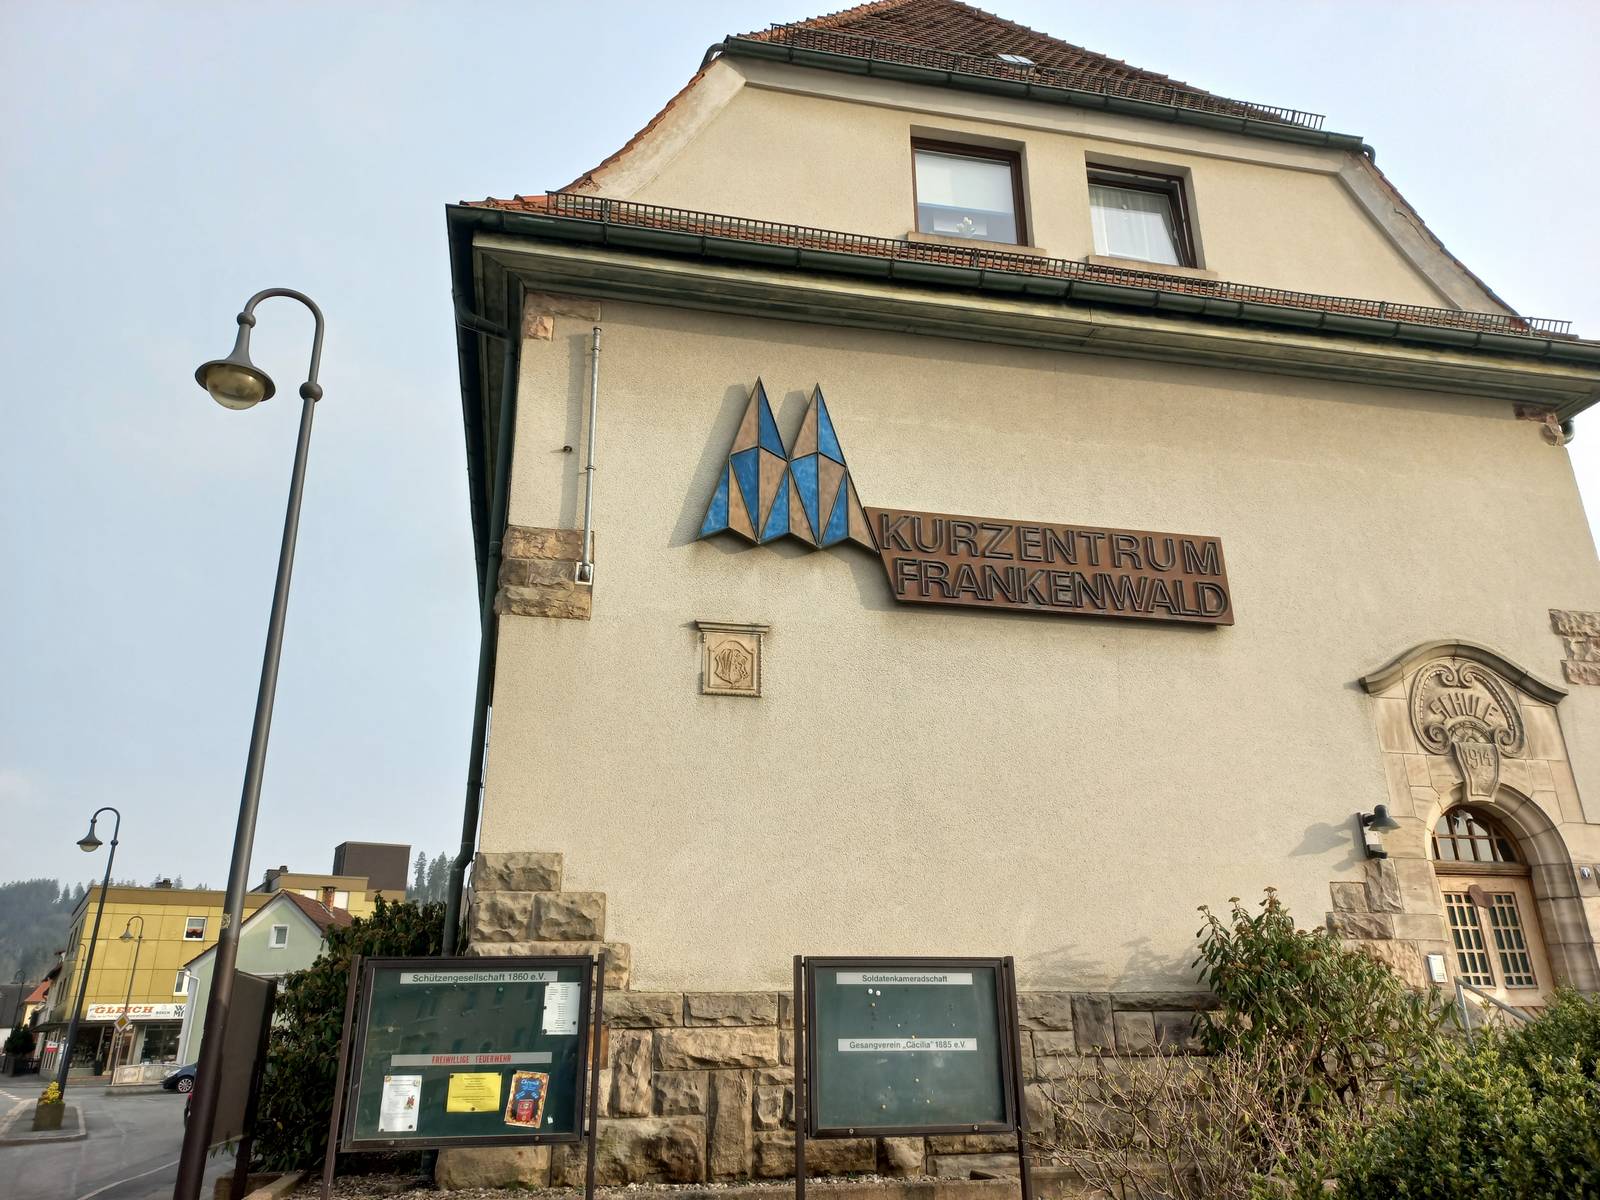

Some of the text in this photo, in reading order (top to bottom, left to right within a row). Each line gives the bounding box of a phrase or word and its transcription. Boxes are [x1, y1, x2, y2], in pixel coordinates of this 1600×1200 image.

[879, 512, 1222, 576] KURZENTRUM
[895, 557, 1228, 618] FRANKENWALD
[1429, 692, 1499, 727] SCHULE
[1463, 749, 1492, 769] 1914
[412, 974, 505, 983] Schützengesellschaft
[508, 973, 528, 981] 1860
[862, 975, 947, 983] Soldatenkameradschaft
[849, 1041, 901, 1050] Gesangverein
[432, 1054, 512, 1064] FREIWILLIGE FEUERWEHR
